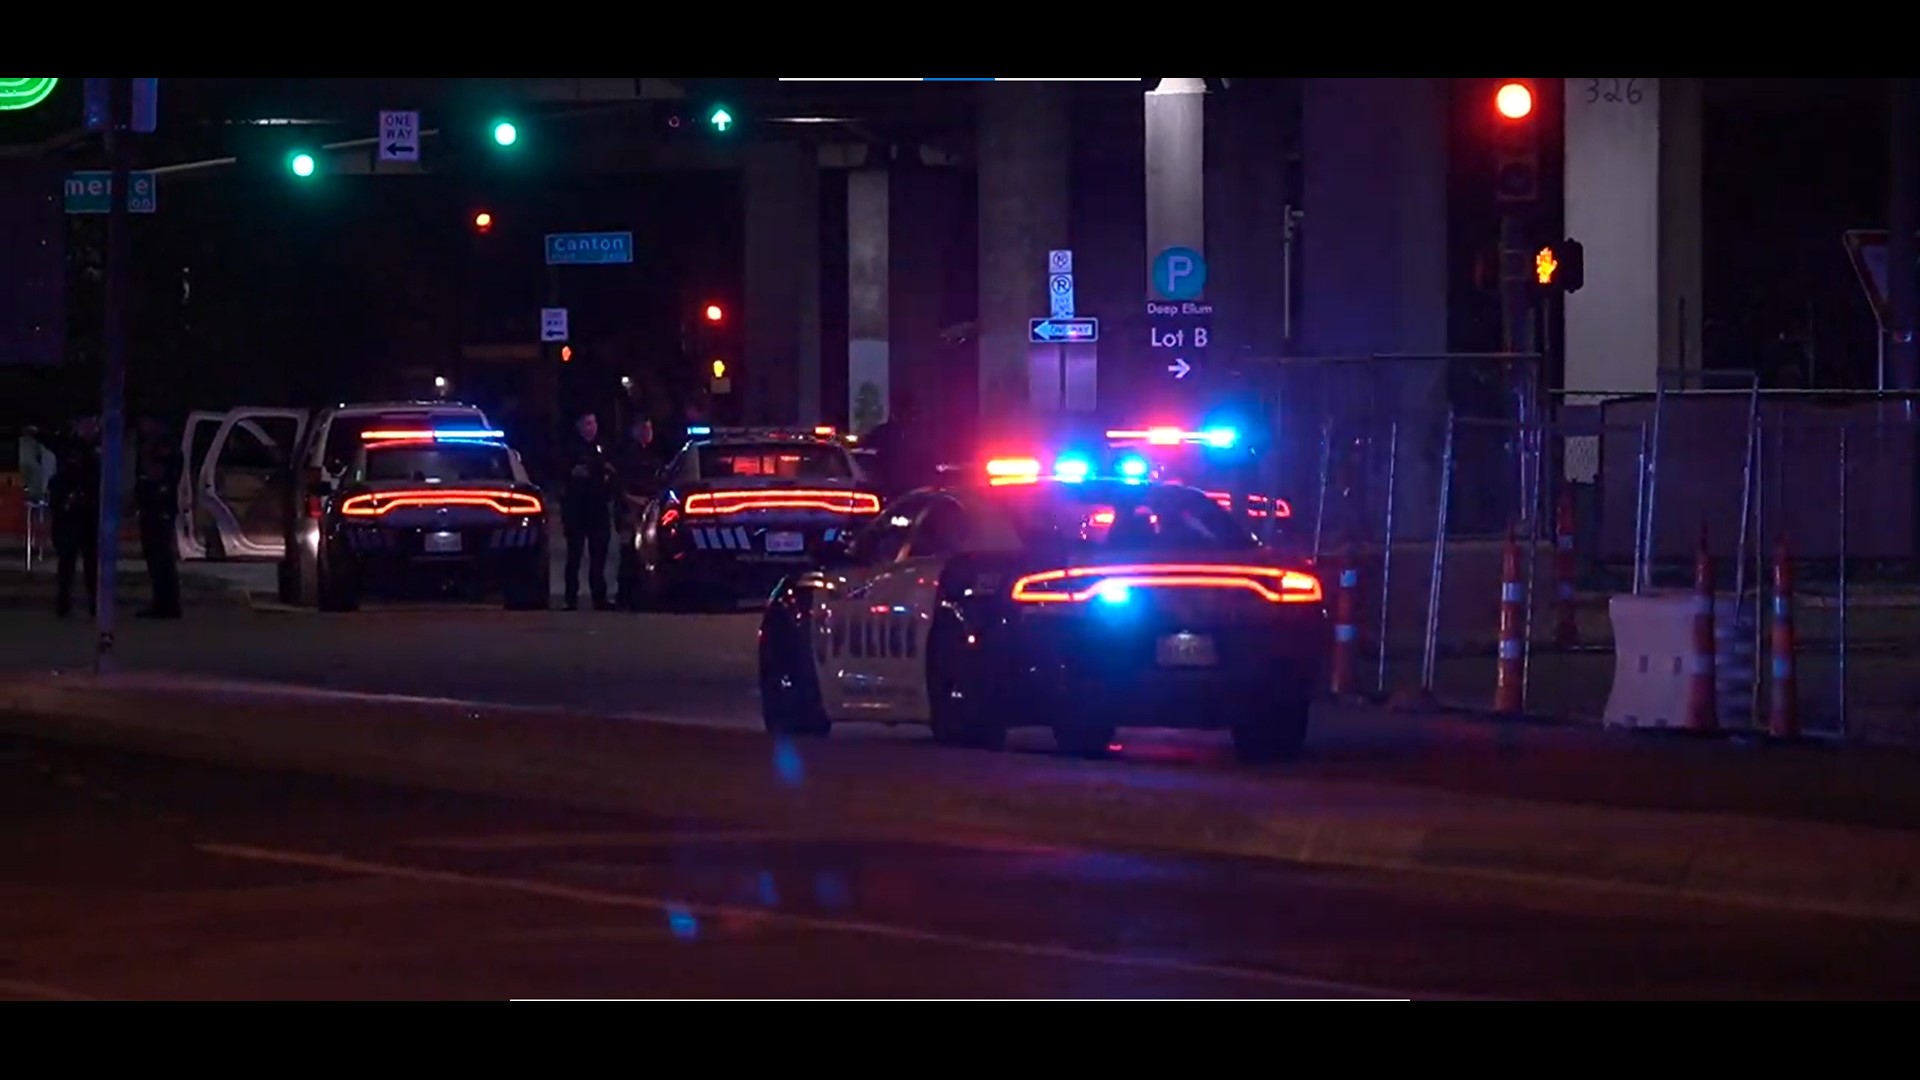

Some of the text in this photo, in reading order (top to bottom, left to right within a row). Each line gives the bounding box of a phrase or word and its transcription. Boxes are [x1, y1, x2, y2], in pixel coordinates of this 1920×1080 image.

[1585, 78, 1642, 104] 326
[385, 114, 411, 127] ONE
[387, 128, 412, 139] WAY
[554, 238, 623, 251] Canton
[1167, 255, 1193, 293] P
[1147, 303, 1213, 316] Deep Ellum
[1152, 327, 1208, 347] Lot B
